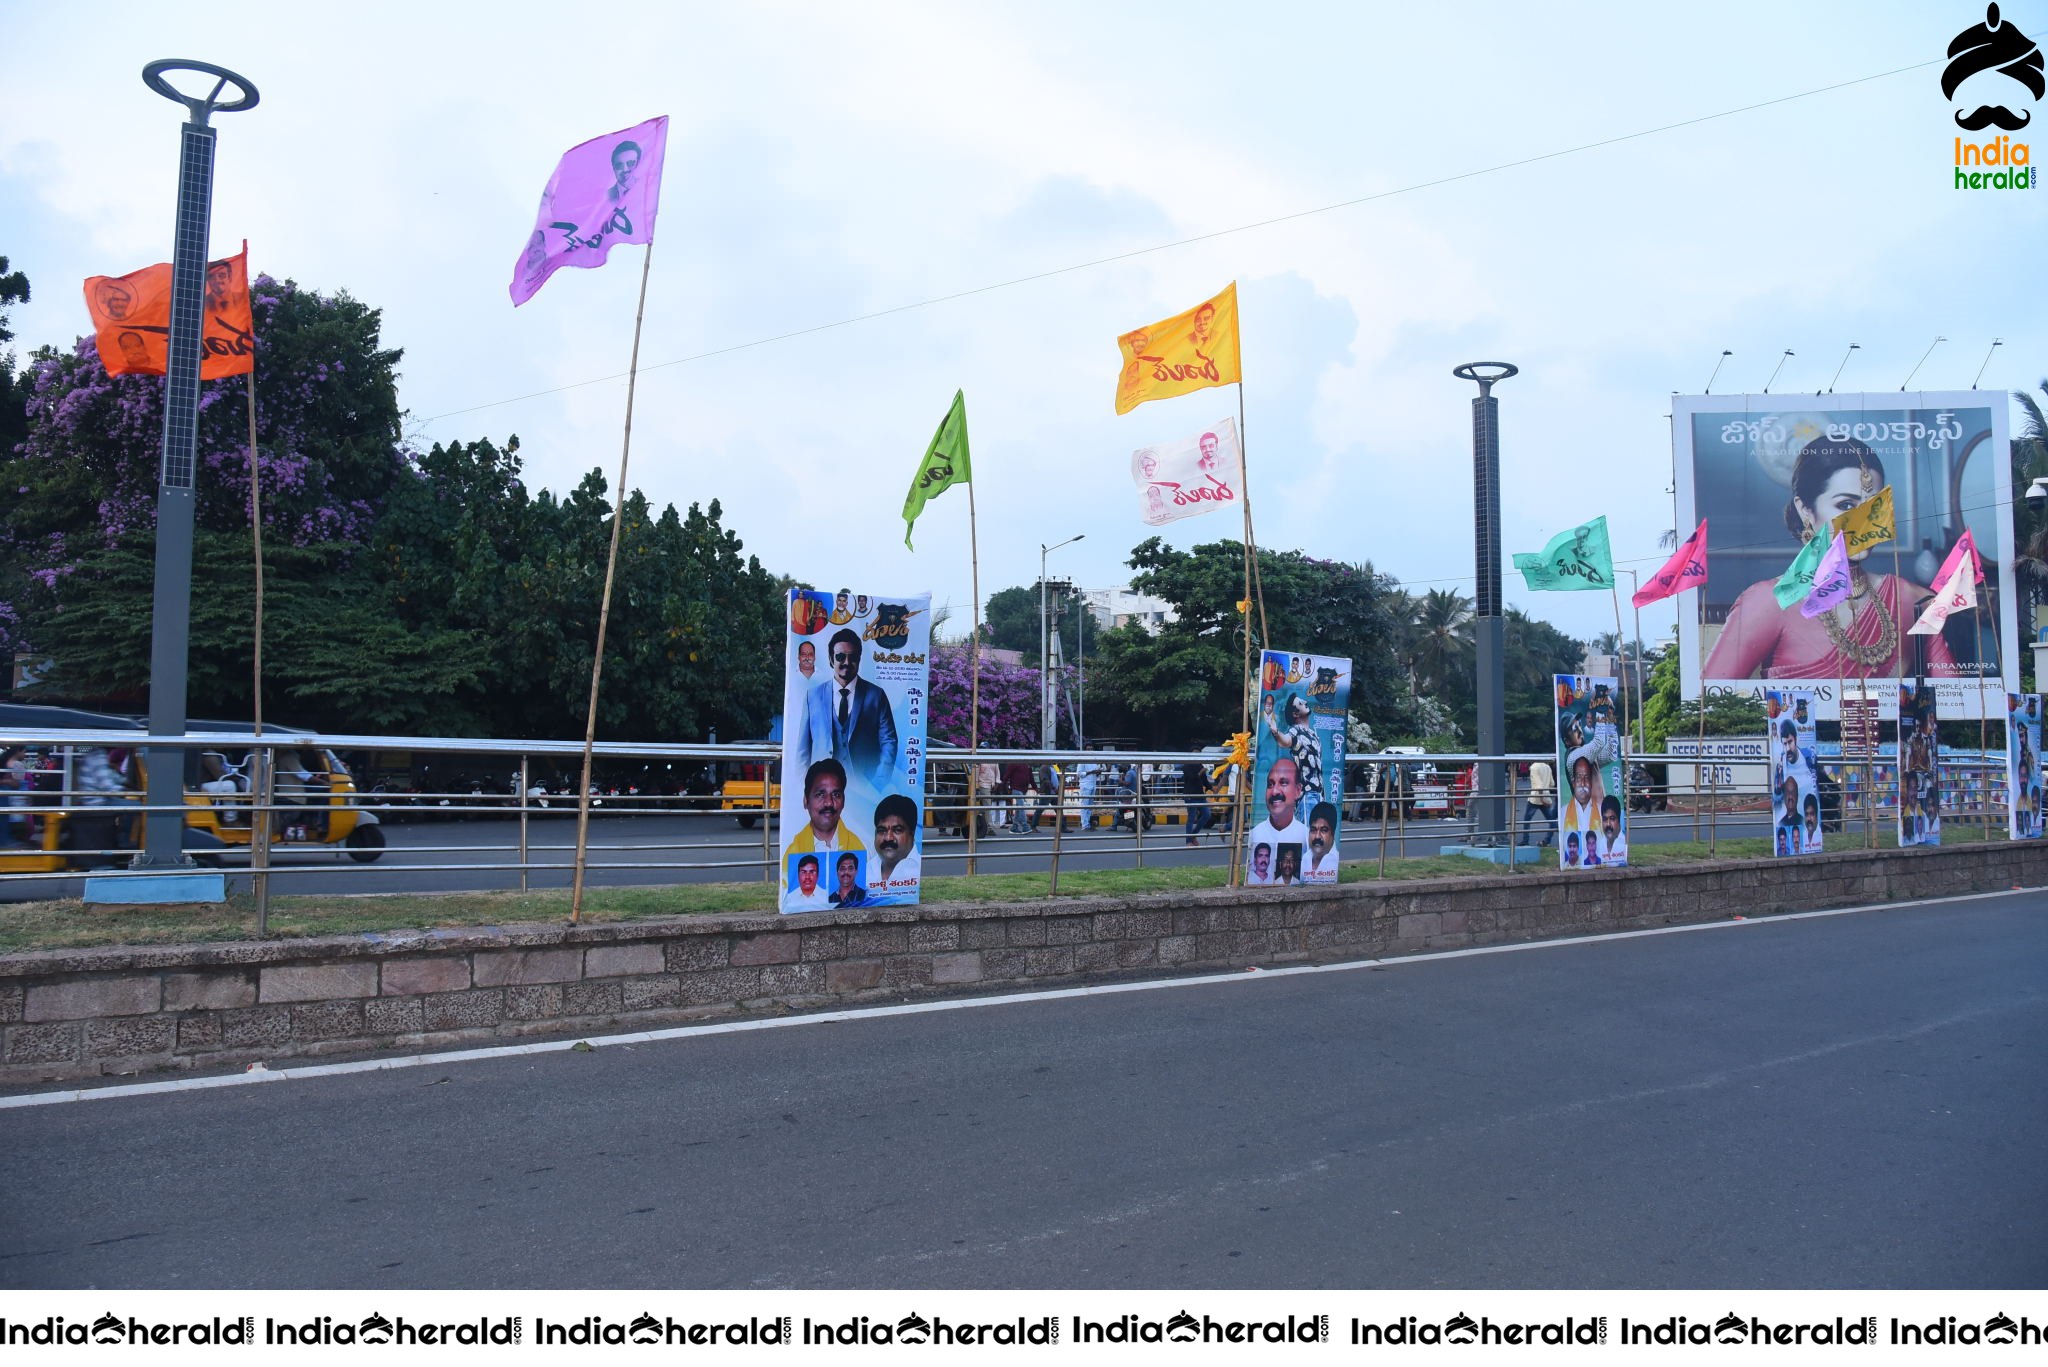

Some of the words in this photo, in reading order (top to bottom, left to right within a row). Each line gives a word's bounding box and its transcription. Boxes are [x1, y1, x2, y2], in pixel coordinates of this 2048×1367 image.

[1759, 448, 1817, 456] TRADITION
[1838, 447, 1863, 455] FINE
[1866, 446, 1921, 455] JEWELLERY
[1927, 662, 1997, 670] PARAMPARA
[1751, 685, 1833, 702] ALAS
